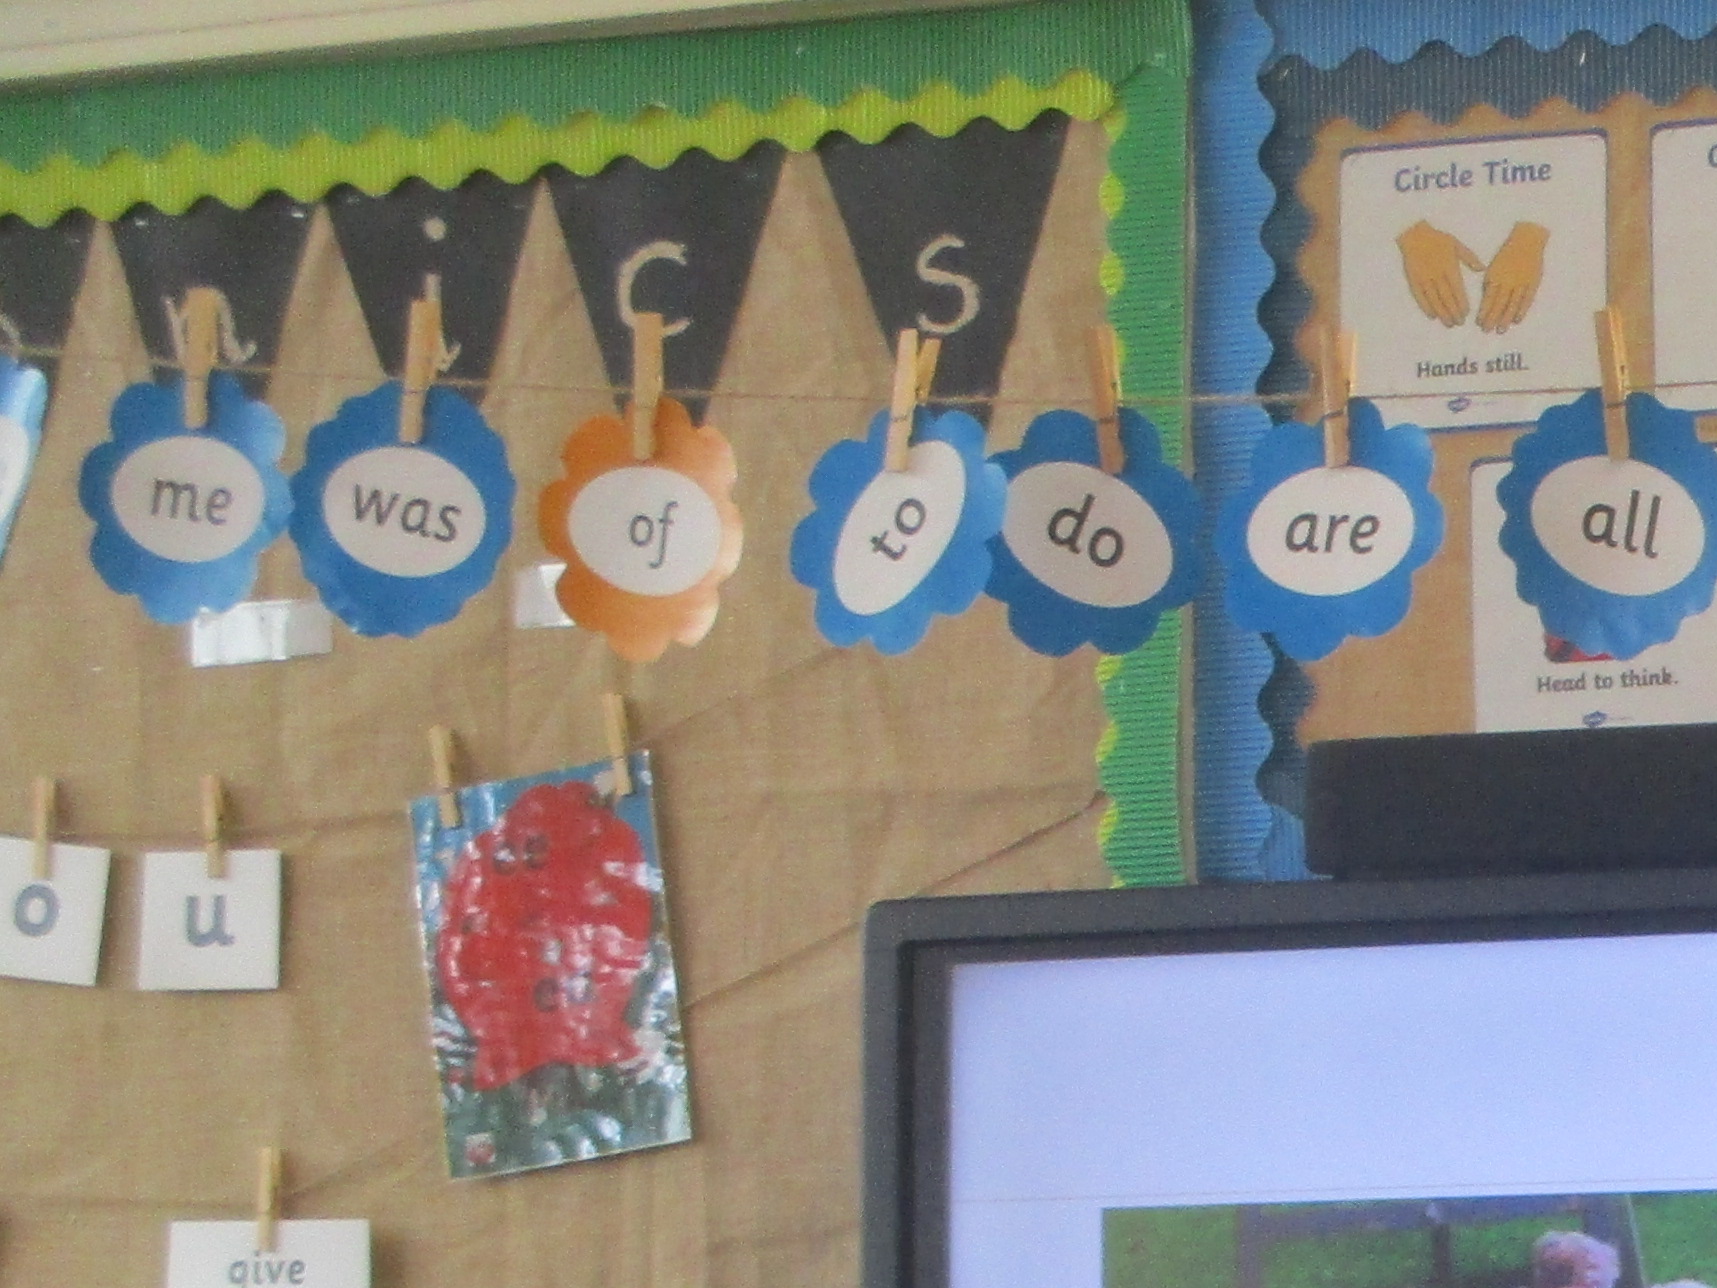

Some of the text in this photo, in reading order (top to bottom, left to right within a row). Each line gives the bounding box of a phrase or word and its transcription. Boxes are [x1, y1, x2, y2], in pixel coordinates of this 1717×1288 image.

[1394, 158, 1552, 193] Circle Time
[1417, 352, 1530, 378] Hands still.
[150, 476, 233, 526] me
[353, 483, 463, 544] was
[1582, 489, 1662, 560] all
[629, 500, 679, 570] of
[869, 496, 928, 562] to
[1046, 493, 1125, 568] do
[1285, 510, 1381, 554] are
[1536, 668, 1679, 694] Head to think.
[14, 883, 60, 938] o
[184, 893, 236, 948] u
